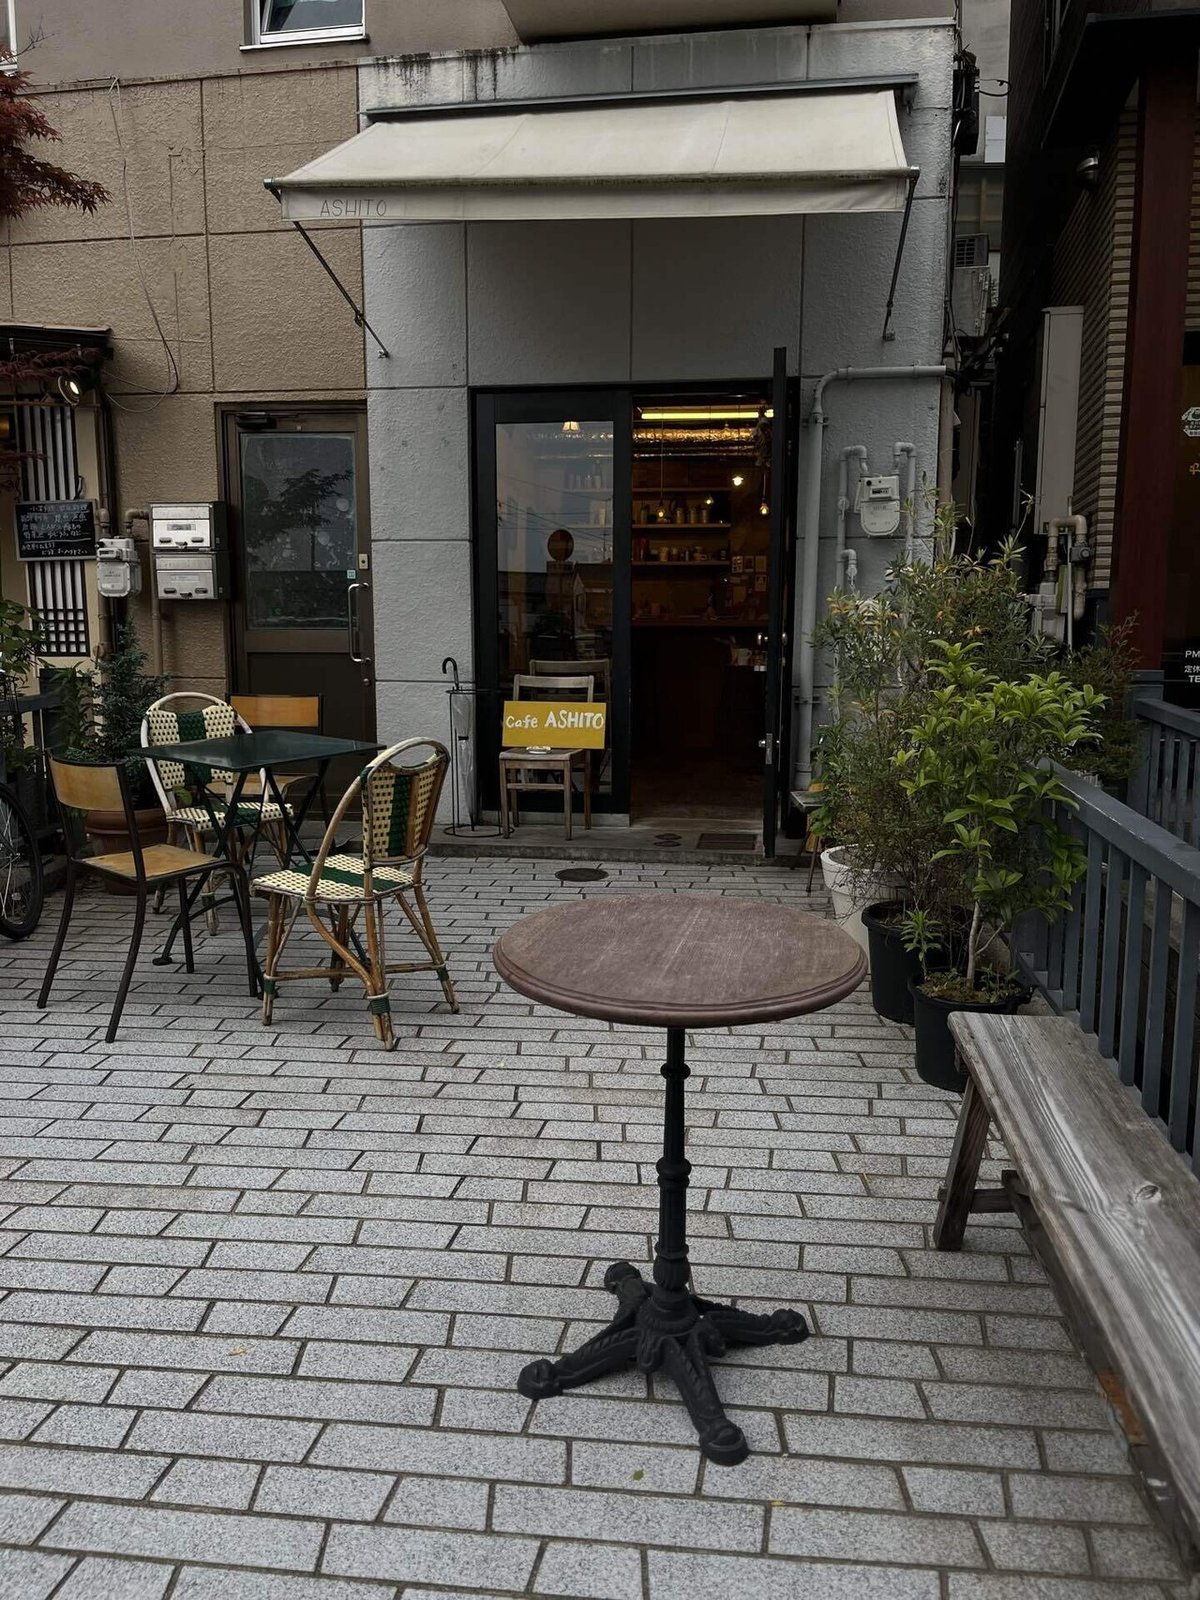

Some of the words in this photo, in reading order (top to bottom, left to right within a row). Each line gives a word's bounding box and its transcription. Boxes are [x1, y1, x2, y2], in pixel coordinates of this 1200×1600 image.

[320, 199, 387, 216] ASHITO
[505, 715, 538, 728] Cafe
[544, 709, 604, 729] ASHITO
